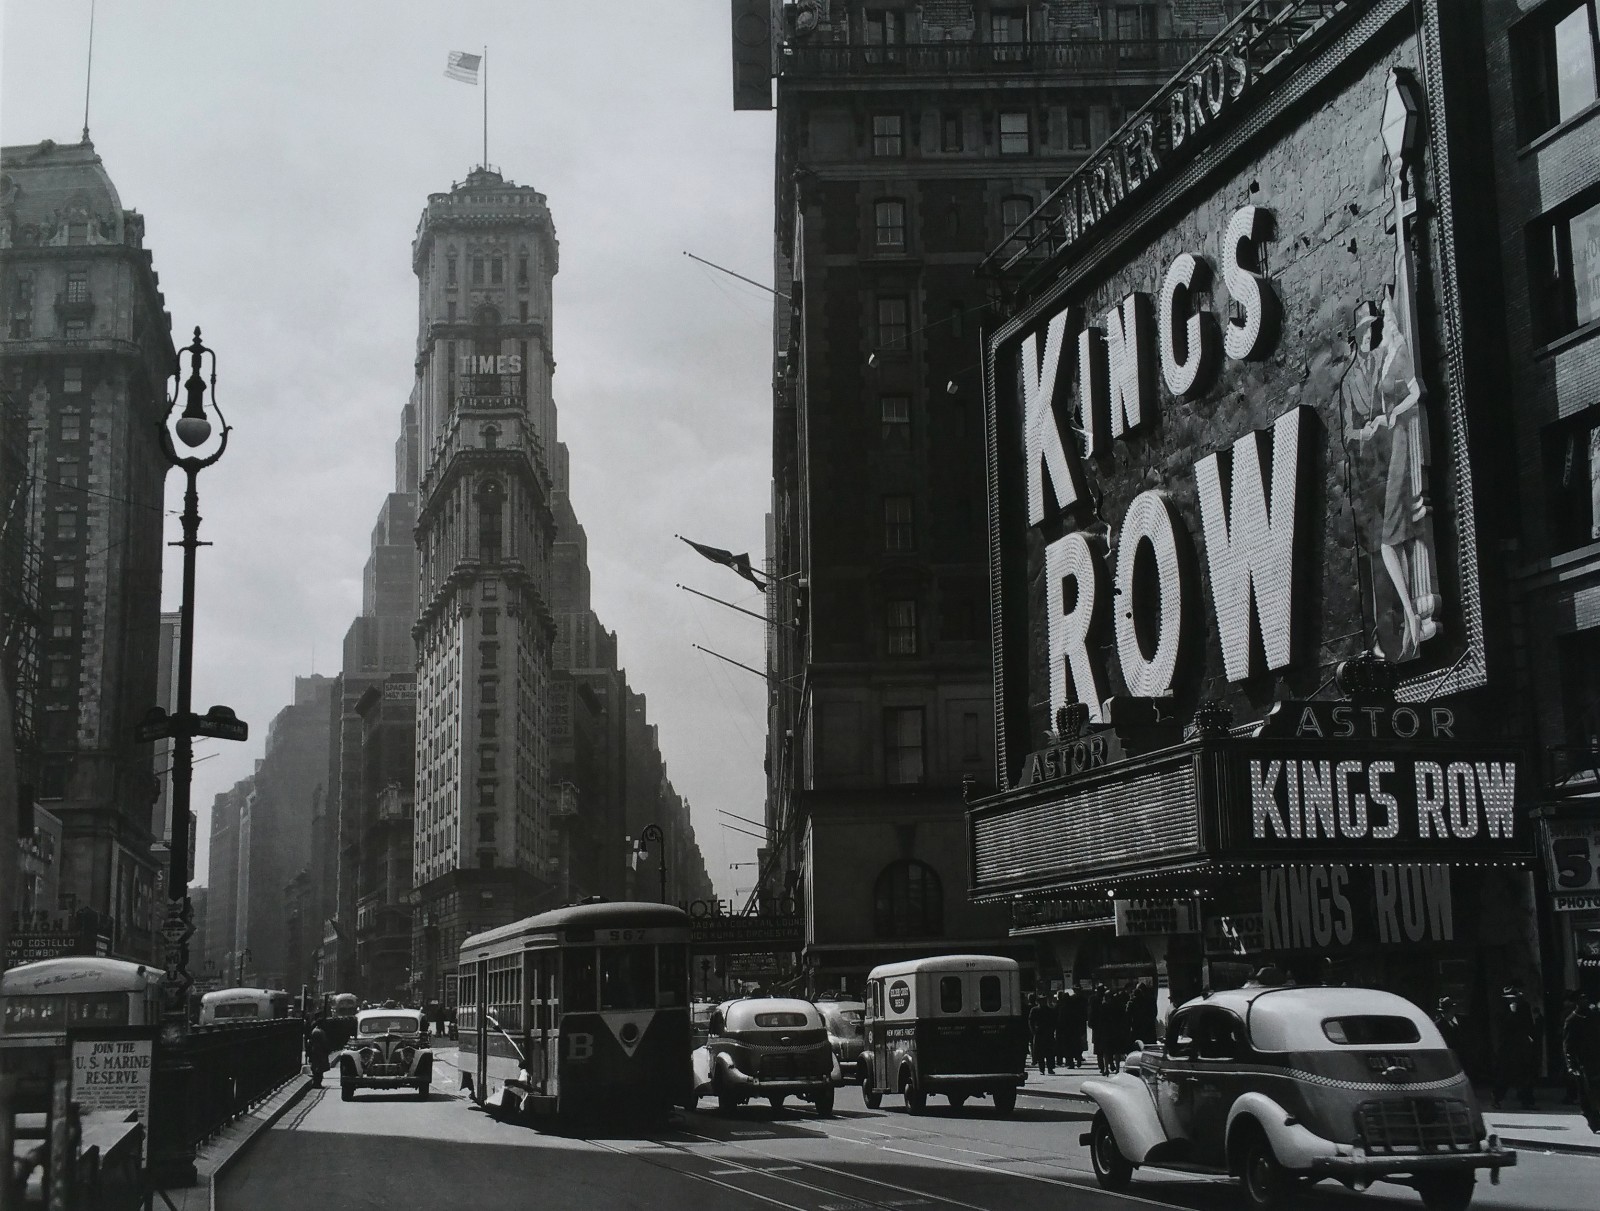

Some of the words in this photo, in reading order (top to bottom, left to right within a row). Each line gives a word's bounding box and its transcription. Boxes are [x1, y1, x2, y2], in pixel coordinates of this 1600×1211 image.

[1059, 119, 1160, 246] WARNER
[459, 355, 522, 375] TIMES
[1021, 204, 1274, 527] KINGS
[1045, 405, 1305, 736] ROW
[1295, 706, 1455, 738] ASTOR
[1031, 735, 1108, 785] ASTOR
[1250, 760, 1399, 838] KINGS
[1414, 761, 1516, 838] ROW
[679, 898, 734, 917] HOTEL
[1260, 864, 1353, 949] KINGS
[1373, 863, 1454, 944] ROW
[776, 918, 805, 927] LOUNG
[23, 949, 60, 957] COWBOY
[29, 939, 75, 947] COSTELLO
[92, 1043, 114, 1055] JOIN
[117, 1043, 136, 1053] THE
[566, 1032, 594, 1061] B
[103, 1055, 151, 1069] MARINE
[86, 1071, 139, 1084] RESERVE
